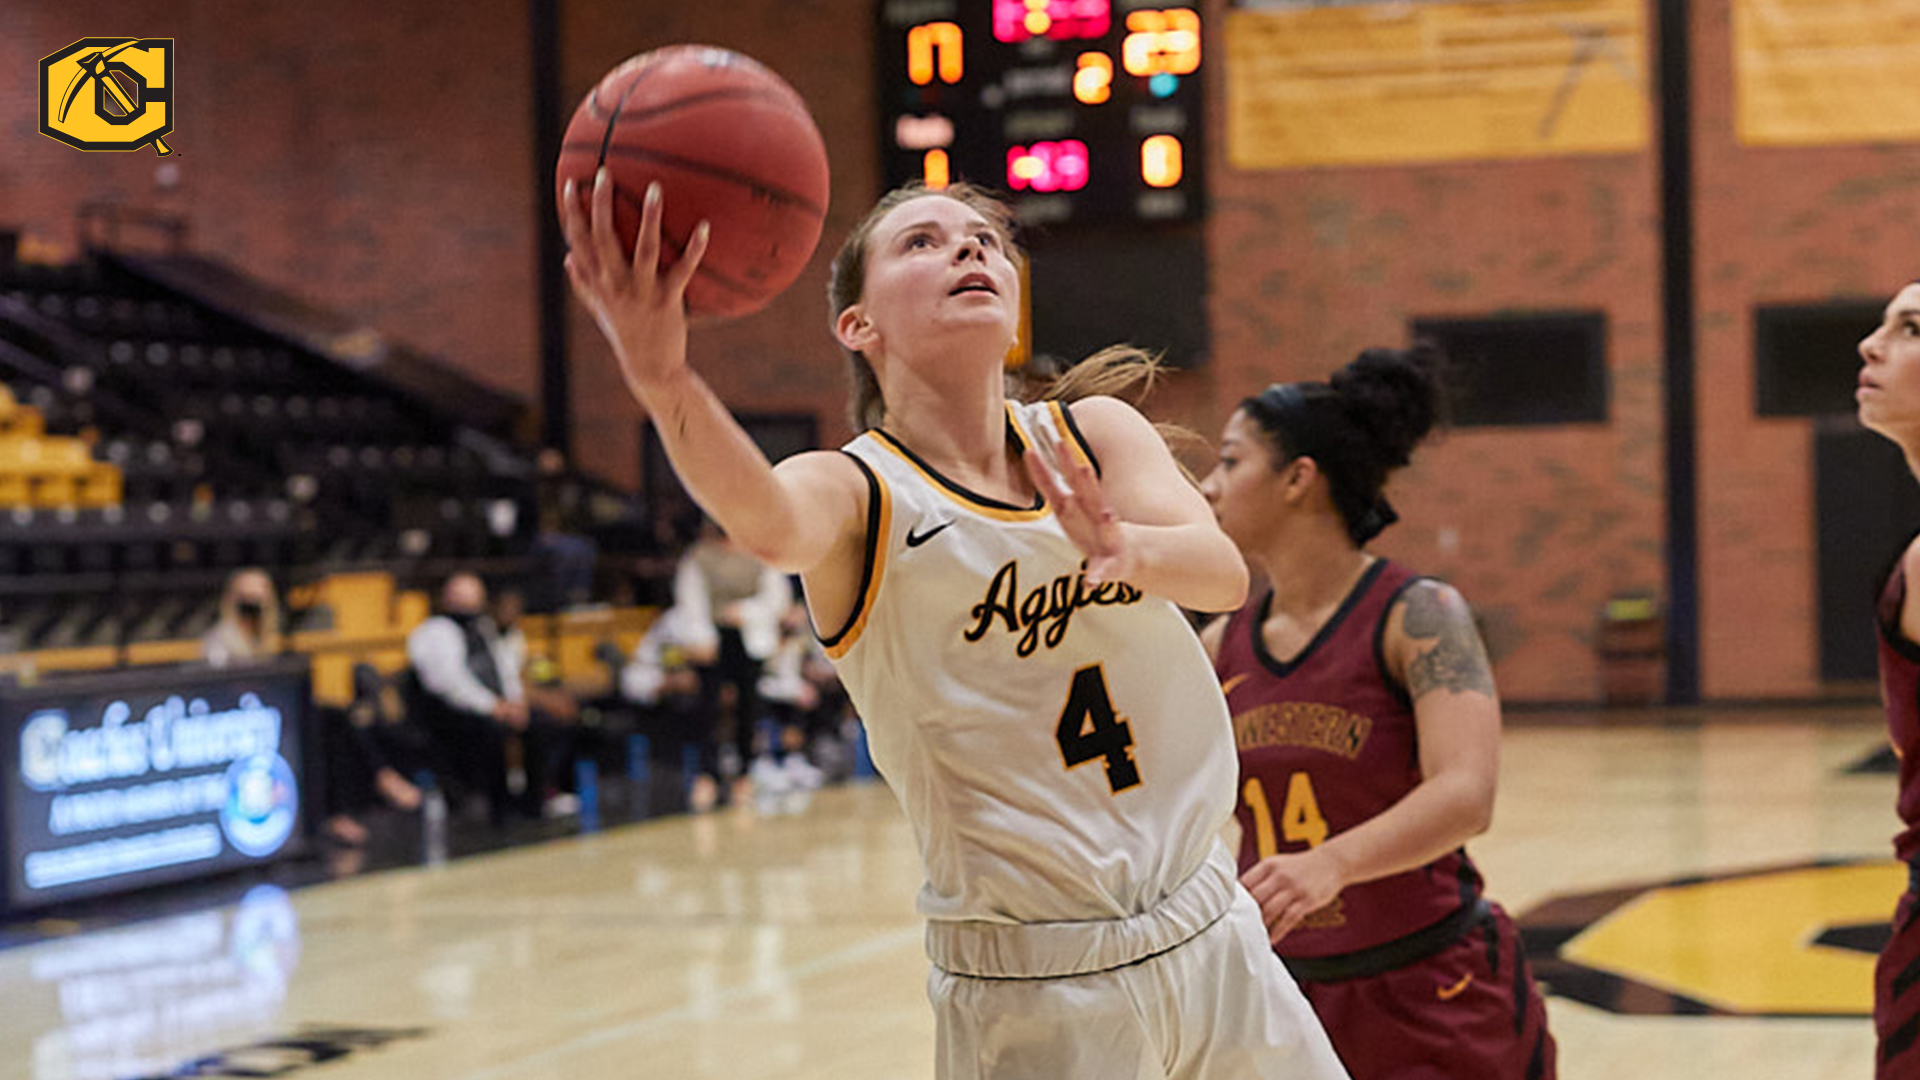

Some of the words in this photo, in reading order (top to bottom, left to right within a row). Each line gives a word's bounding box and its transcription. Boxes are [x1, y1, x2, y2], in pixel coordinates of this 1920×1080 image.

[964, 559, 1143, 659] Aggies
[1054, 660, 1143, 796] 4
[1233, 701, 1374, 760] WESTERN
[1243, 772, 1329, 861] 14
